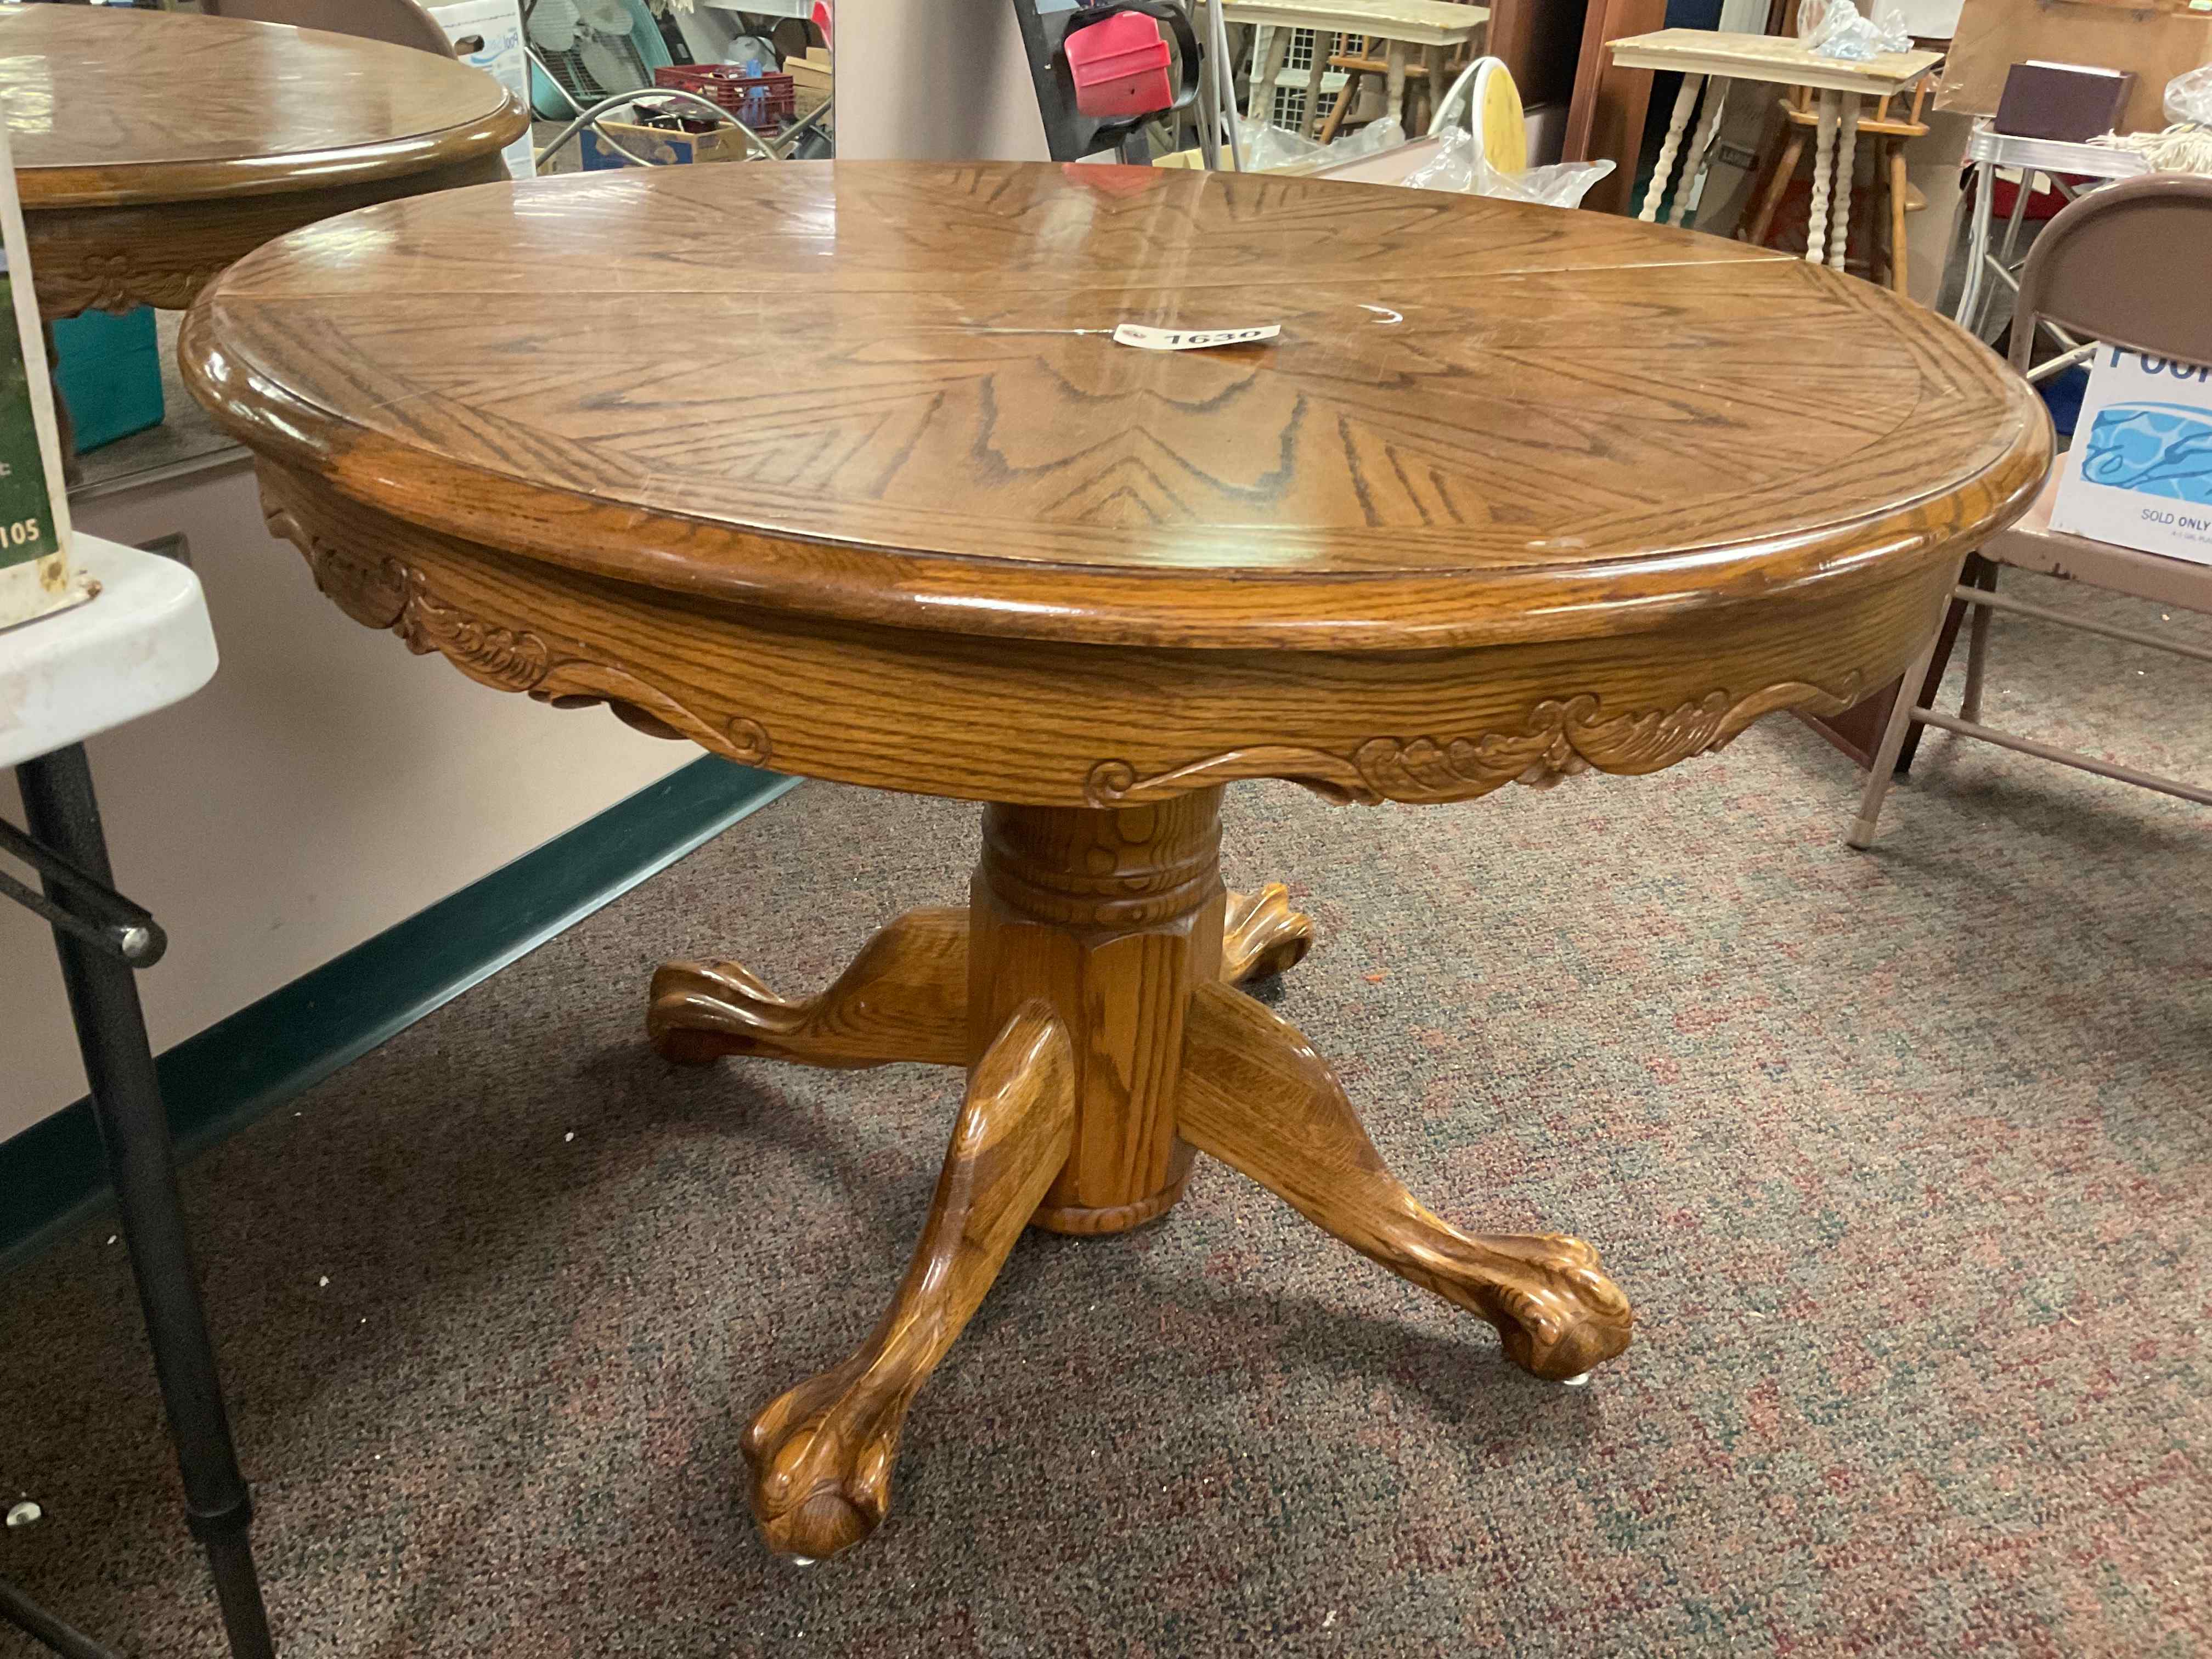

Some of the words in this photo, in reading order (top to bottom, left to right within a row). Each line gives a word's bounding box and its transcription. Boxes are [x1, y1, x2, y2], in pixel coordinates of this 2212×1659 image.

[1164, 331, 1261, 344] 1630
[2141, 509, 2174, 524] SOLD
[2178, 517, 2211, 531] ONLY
